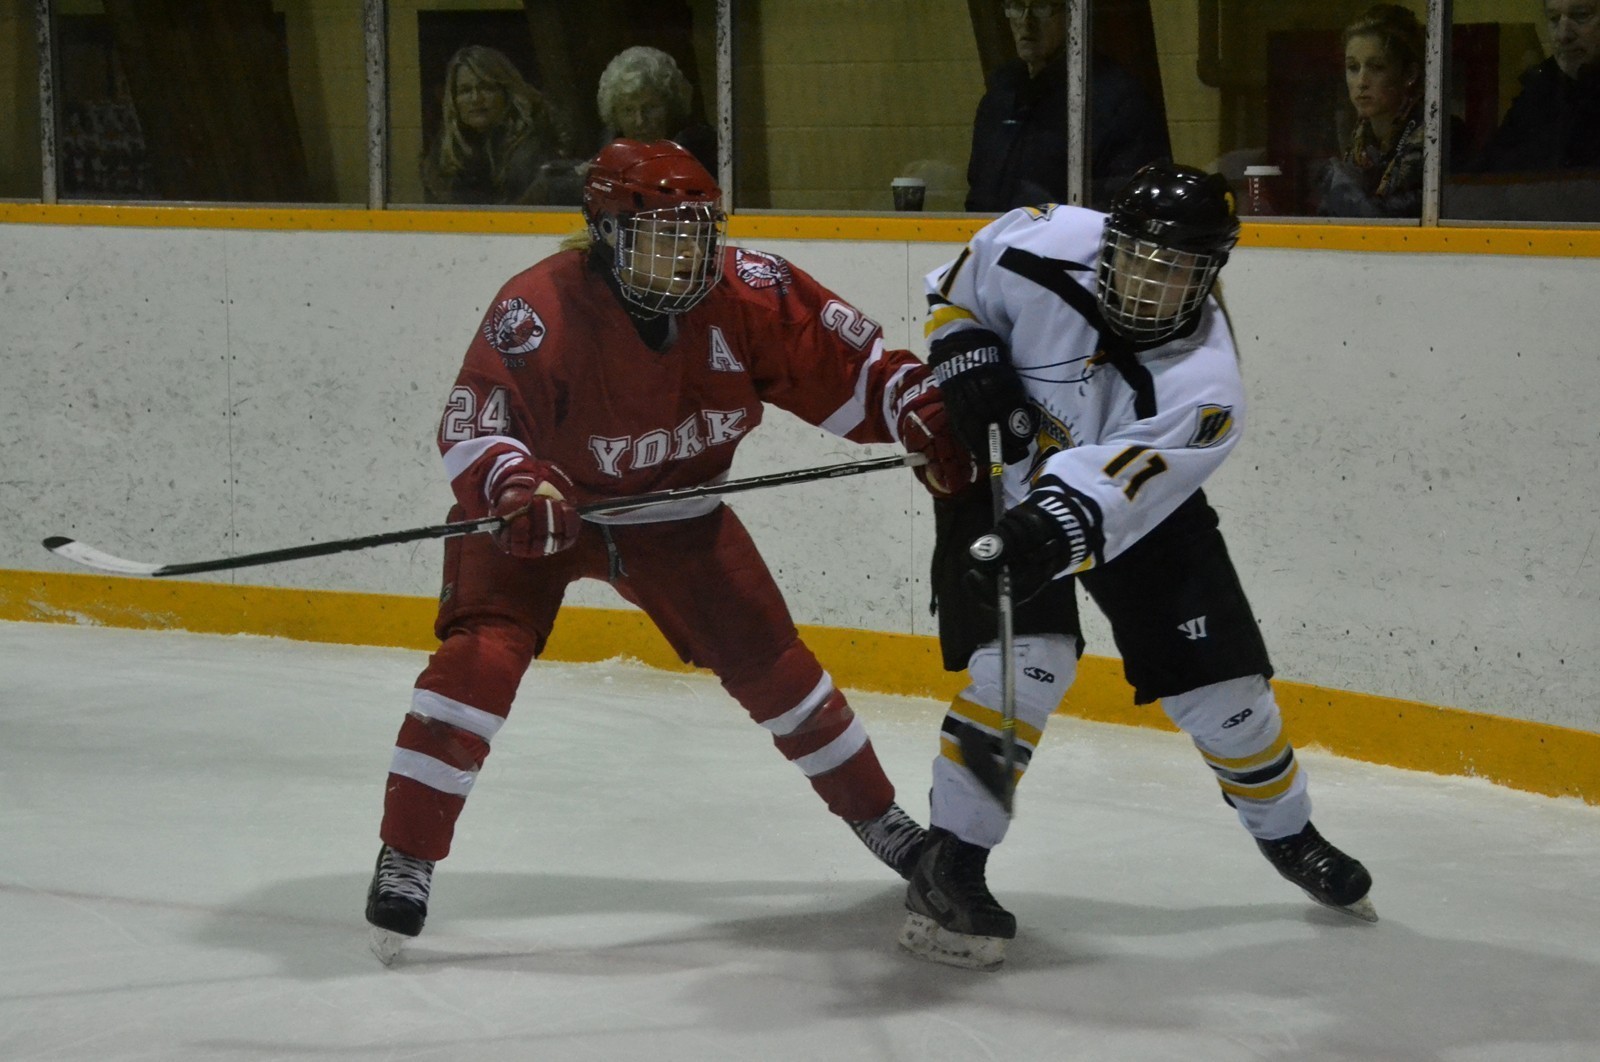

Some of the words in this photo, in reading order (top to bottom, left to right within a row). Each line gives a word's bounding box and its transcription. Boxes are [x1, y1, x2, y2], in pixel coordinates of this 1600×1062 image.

[1396, 119, 1416, 151] Canon
[709, 325, 744, 371] A
[932, 346, 1000, 383] ARRIOR
[442, 386, 511, 443] 24
[588, 408, 747, 478] YORK
